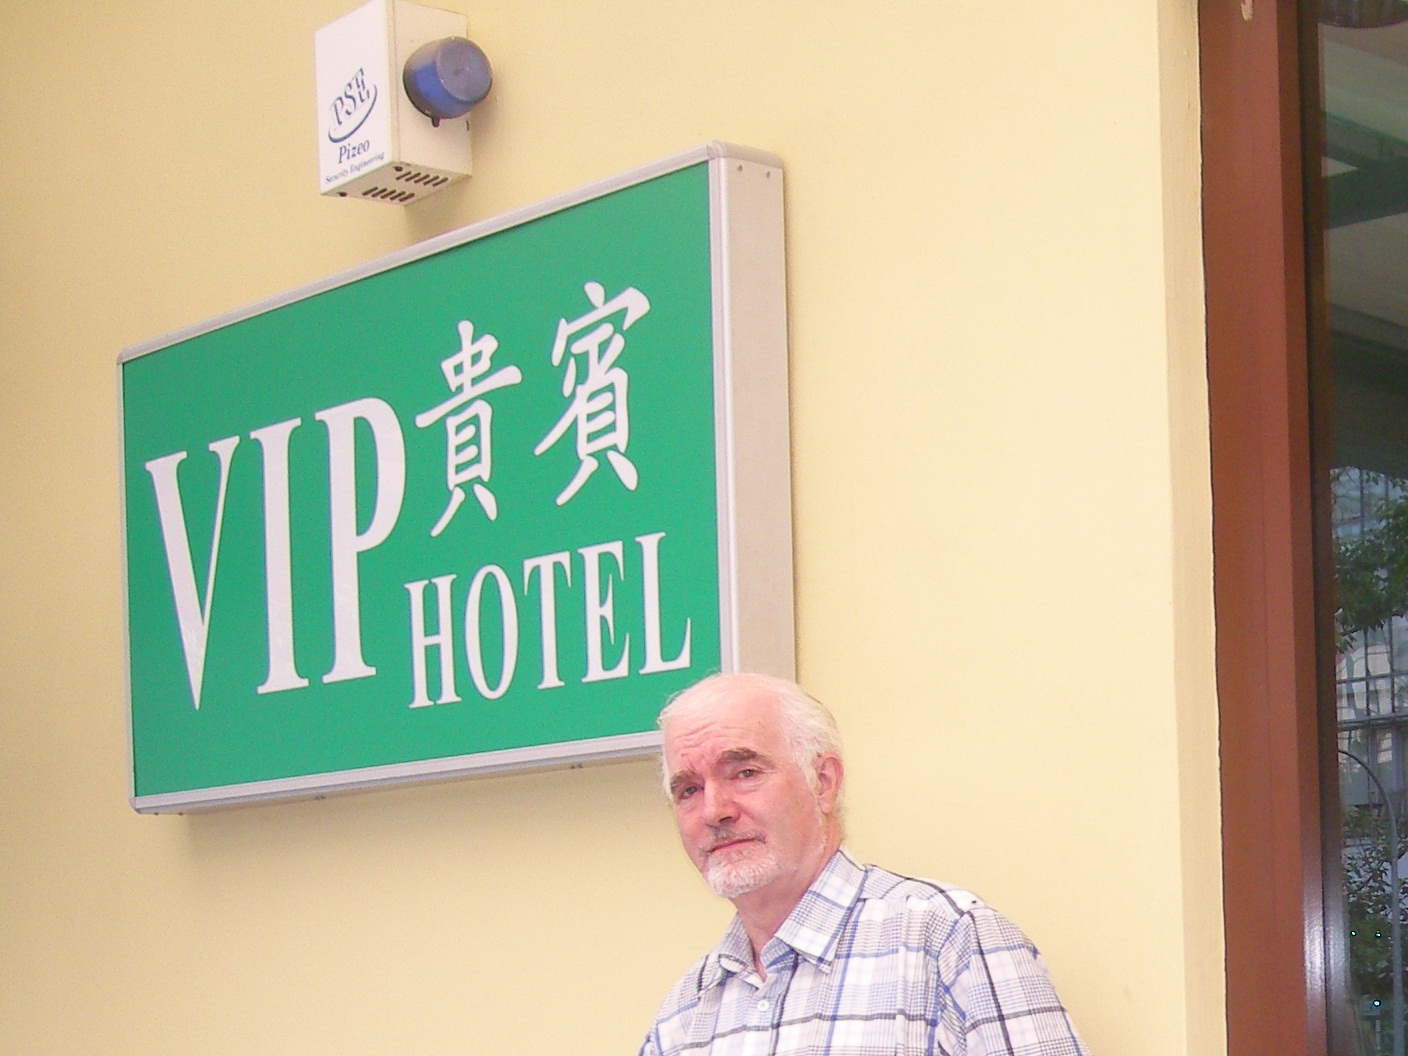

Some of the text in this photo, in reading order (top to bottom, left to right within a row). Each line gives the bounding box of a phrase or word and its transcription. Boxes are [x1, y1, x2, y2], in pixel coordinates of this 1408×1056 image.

[325, 152, 385, 184] Security Engineering
[338, 139, 370, 164] Pizeo
[415, 281, 650, 537] 貴賓
[145, 397, 406, 710] VIP
[404, 531, 692, 709] HOTEL
